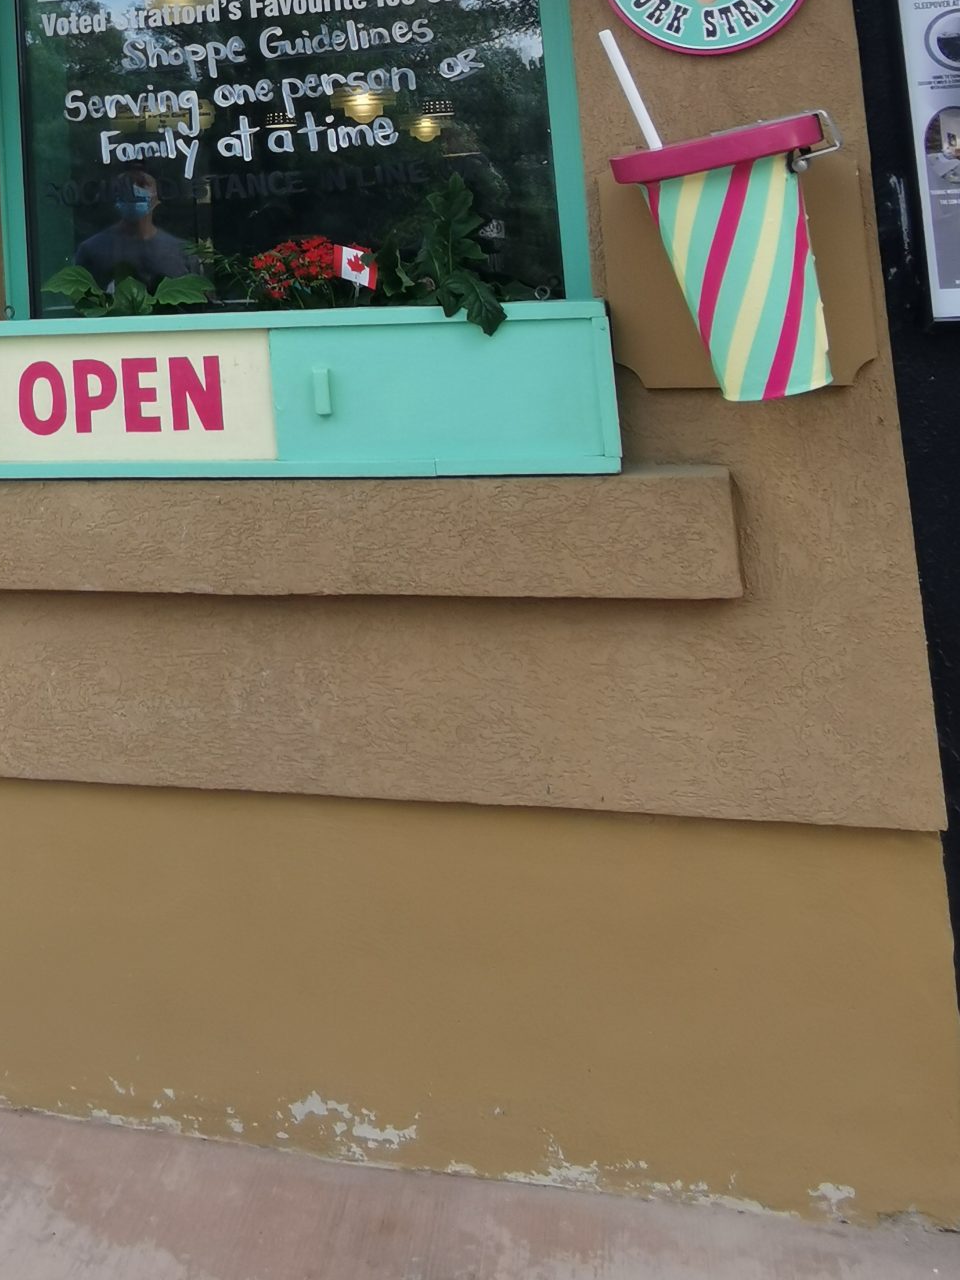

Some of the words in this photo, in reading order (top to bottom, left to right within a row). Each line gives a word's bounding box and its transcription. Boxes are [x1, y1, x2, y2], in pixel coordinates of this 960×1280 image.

[41, 9, 107, 37] Voted
[121, 35, 247, 81] Shoppe
[259, 18, 435, 59] Guidelines
[63, 84, 198, 138] Serving
[214, 82, 274, 108] one
[281, 67, 417, 119] person
[100, 127, 200, 180] Family
[217, 115, 262, 161] at
[268, 127, 294, 154] a
[296, 111, 399, 153] time
[18, 355, 225, 436] OPEN
